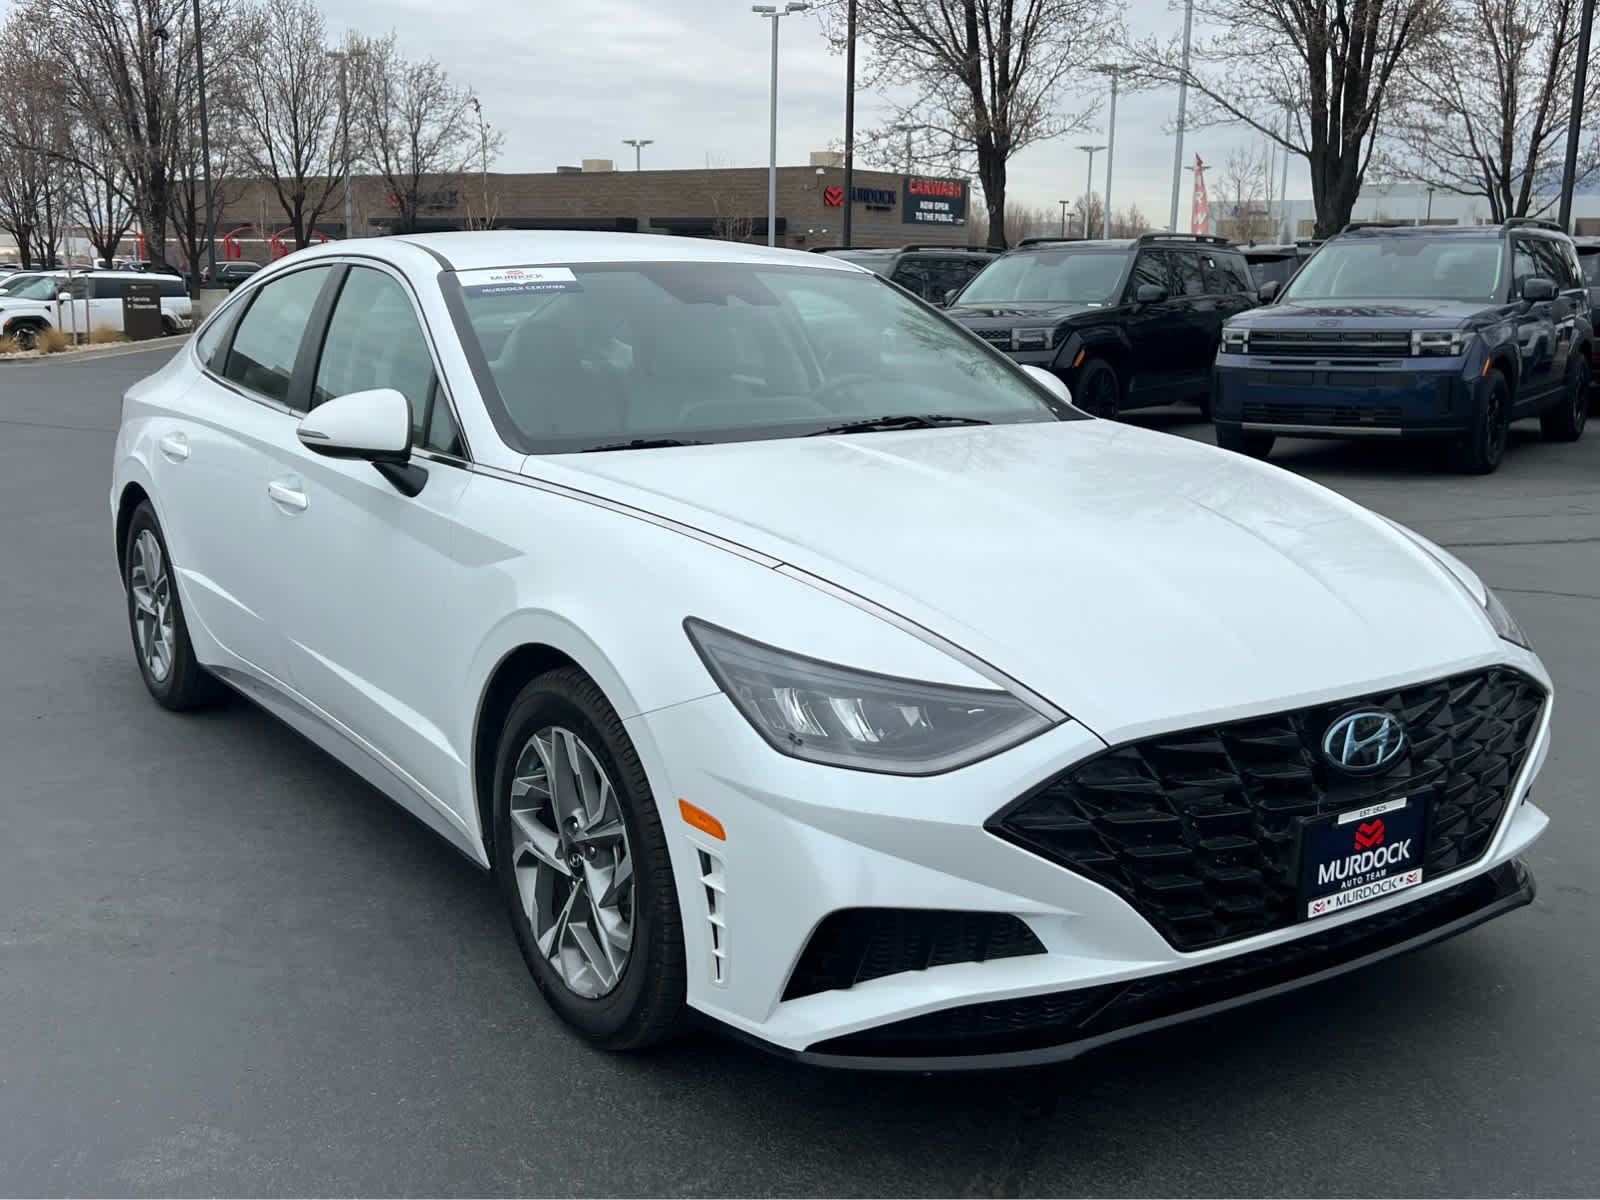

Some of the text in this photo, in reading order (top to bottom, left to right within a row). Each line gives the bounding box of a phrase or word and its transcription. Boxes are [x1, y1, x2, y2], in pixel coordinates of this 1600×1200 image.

[851, 187, 897, 205] URDOCK
[909, 178, 962, 198] CARWASH
[919, 201, 950, 211] NOW OPEN
[915, 211, 922, 220] TO
[923, 212, 934, 221] THE
[934, 212, 954, 222] PUBLIC
[1318, 838, 1412, 885] MURDOCK
[1340, 869, 1387, 889] AUTO TEAM
[1336, 878, 1398, 907] MURDOCK
